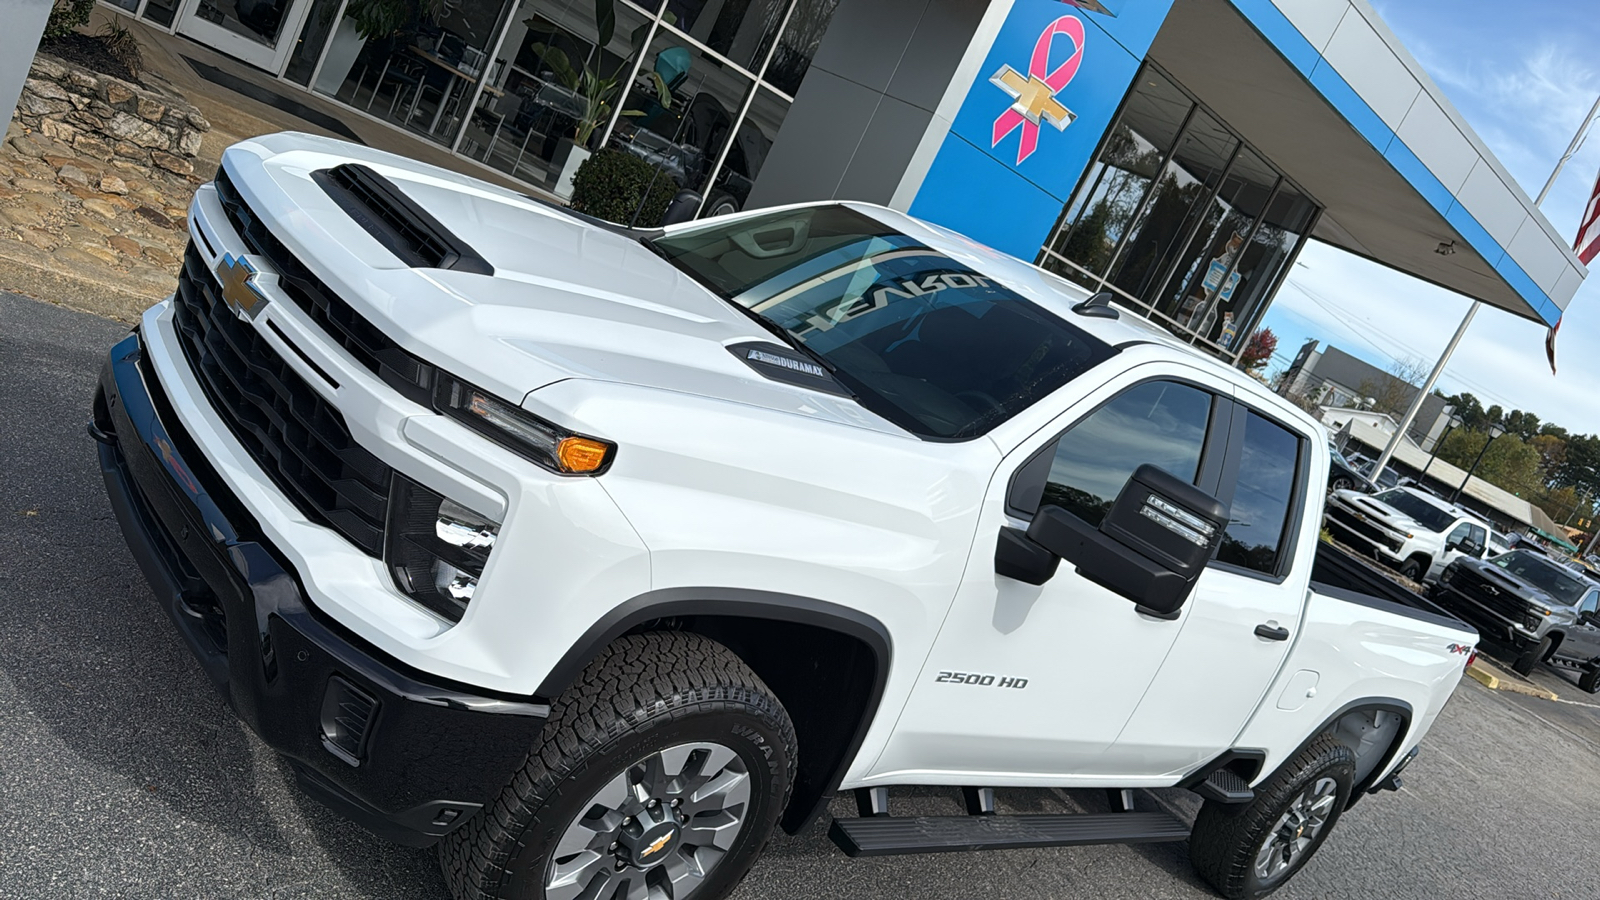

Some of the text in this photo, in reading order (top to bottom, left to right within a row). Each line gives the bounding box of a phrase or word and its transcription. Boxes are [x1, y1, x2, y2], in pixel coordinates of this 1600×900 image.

[780, 356, 824, 377] DURAMAX
[935, 671, 1029, 689] 2500 HD
[730, 722, 780, 798] WRANG
